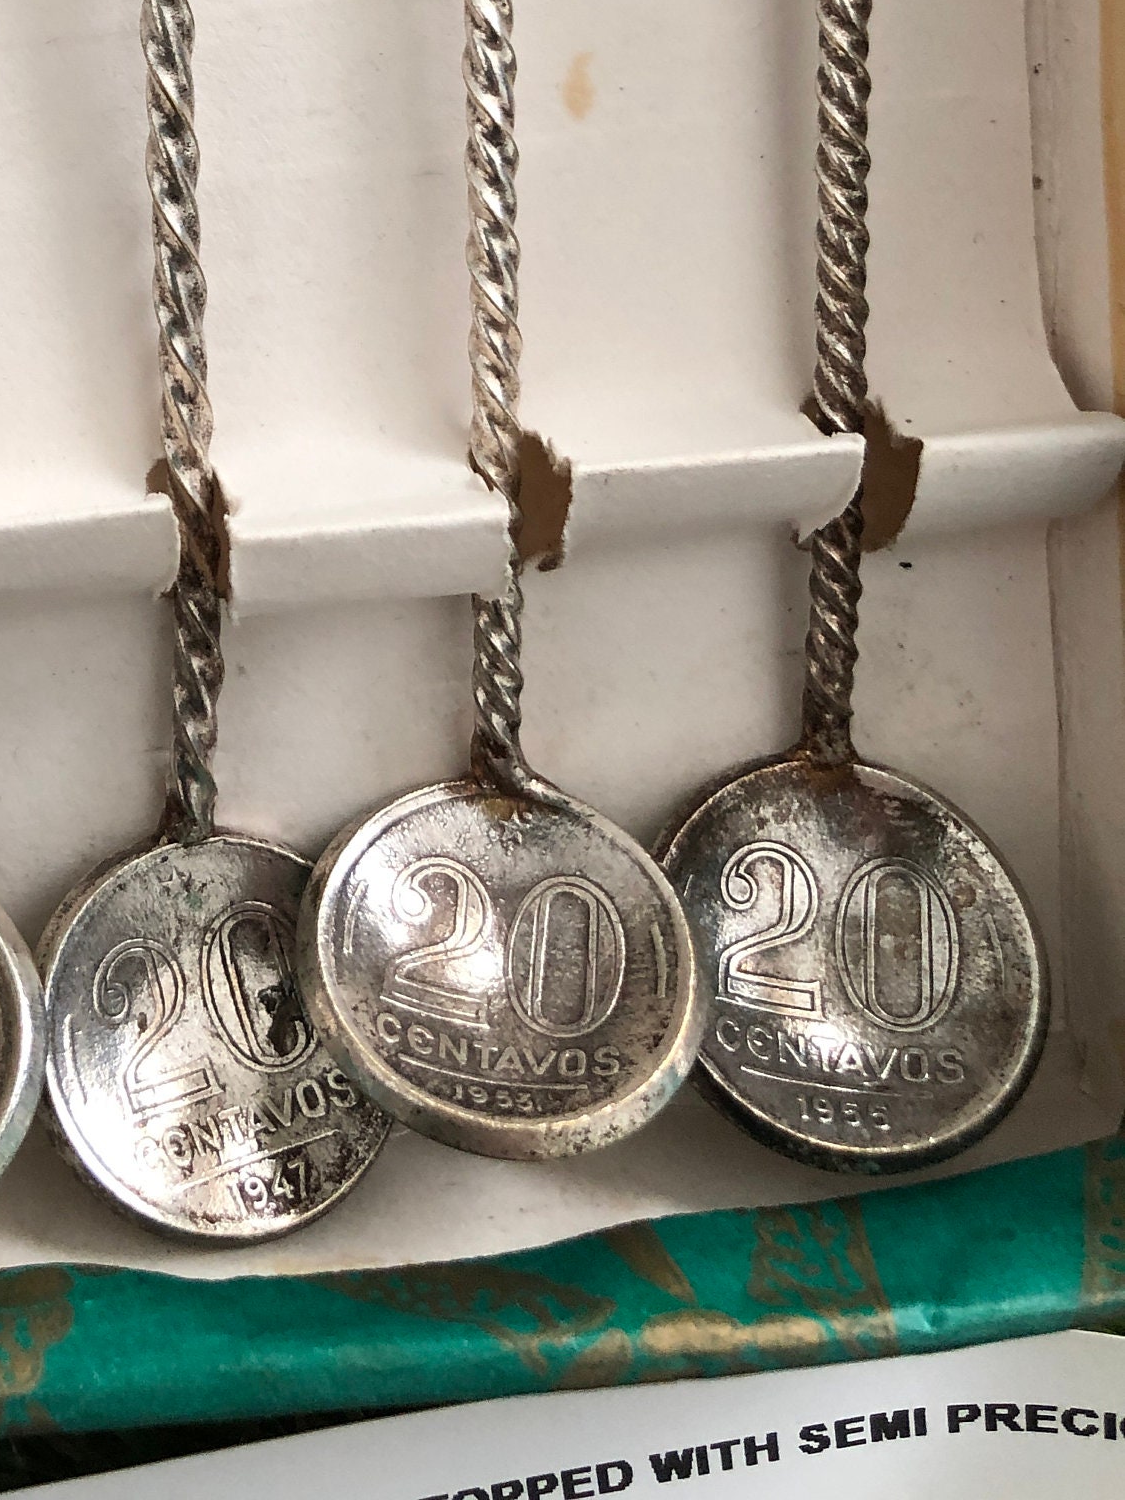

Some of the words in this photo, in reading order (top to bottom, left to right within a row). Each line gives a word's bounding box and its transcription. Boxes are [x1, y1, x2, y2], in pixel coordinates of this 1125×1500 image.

[380, 855, 626, 1038] 20
[715, 840, 961, 1032] 20
[92, 900, 319, 1123] 20
[375, 1011, 621, 1077] CENTAVOS
[715, 1015, 965, 1084] CENTAVOS
[133, 1067, 357, 1172] CENTAVOS
[227, 1160, 307, 1216] 1947
[418, 1459, 634, 1500] PPED
[649, 1432, 780, 1483] WITH
[798, 1407, 927, 1455] SEMI
[947, 1403, 1125, 1440] PRECI
